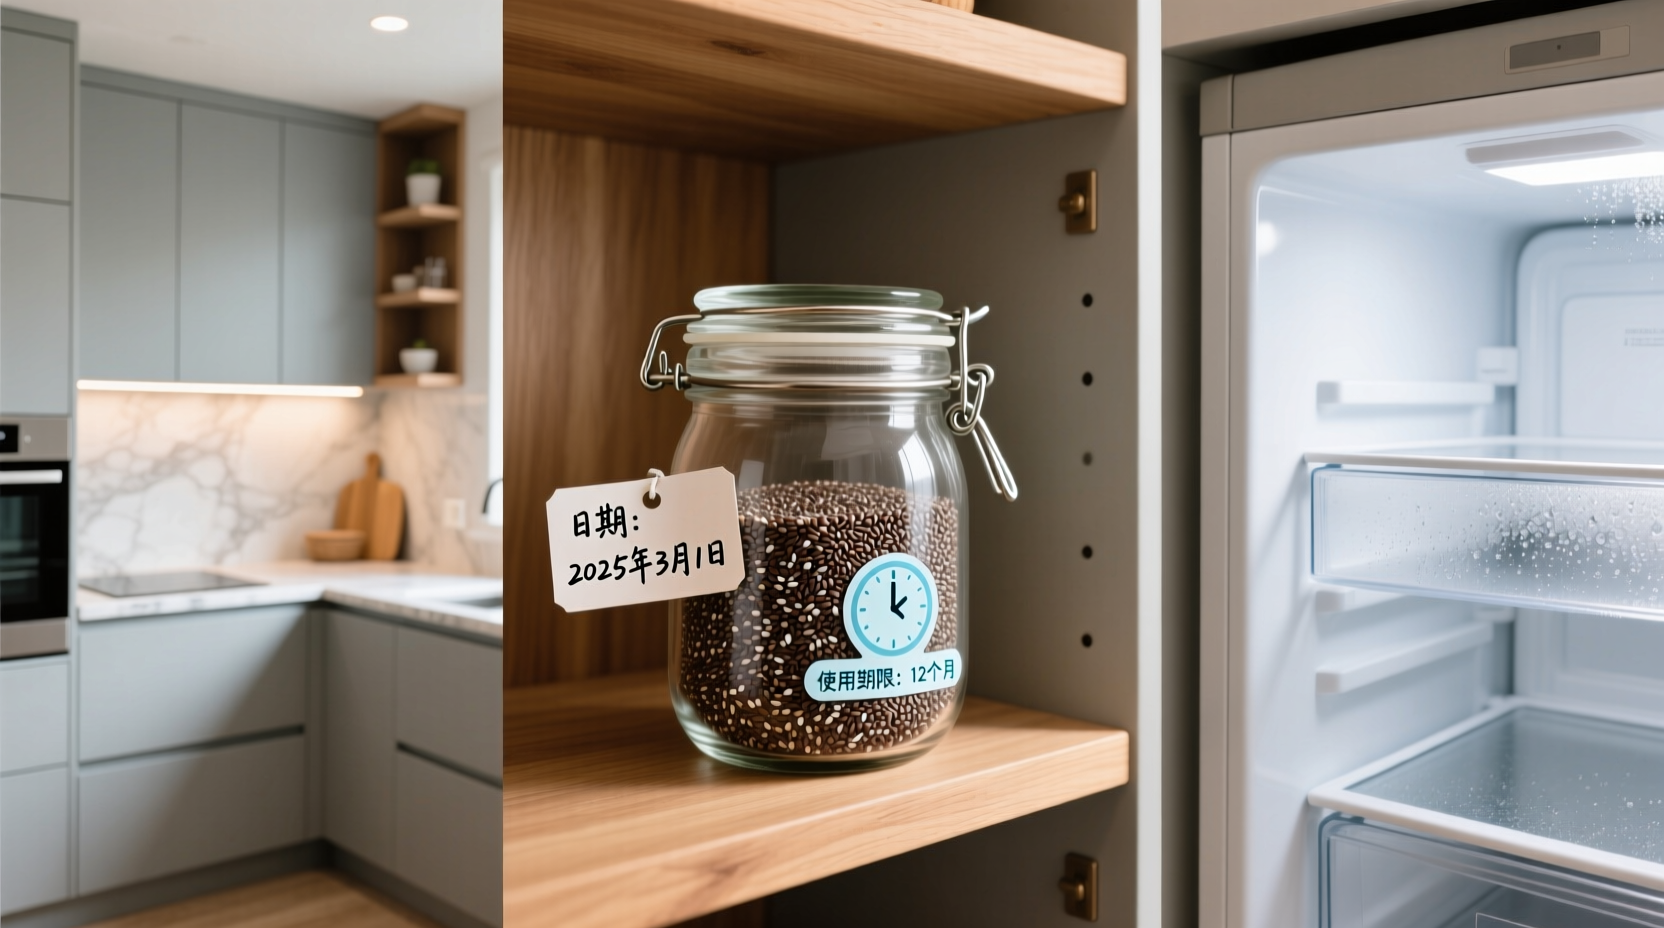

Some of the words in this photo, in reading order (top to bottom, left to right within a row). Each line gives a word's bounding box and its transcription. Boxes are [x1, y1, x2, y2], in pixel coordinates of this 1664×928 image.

[573, 502, 640, 539] 日期：
[568, 540, 725, 586] 2025年3月1日
